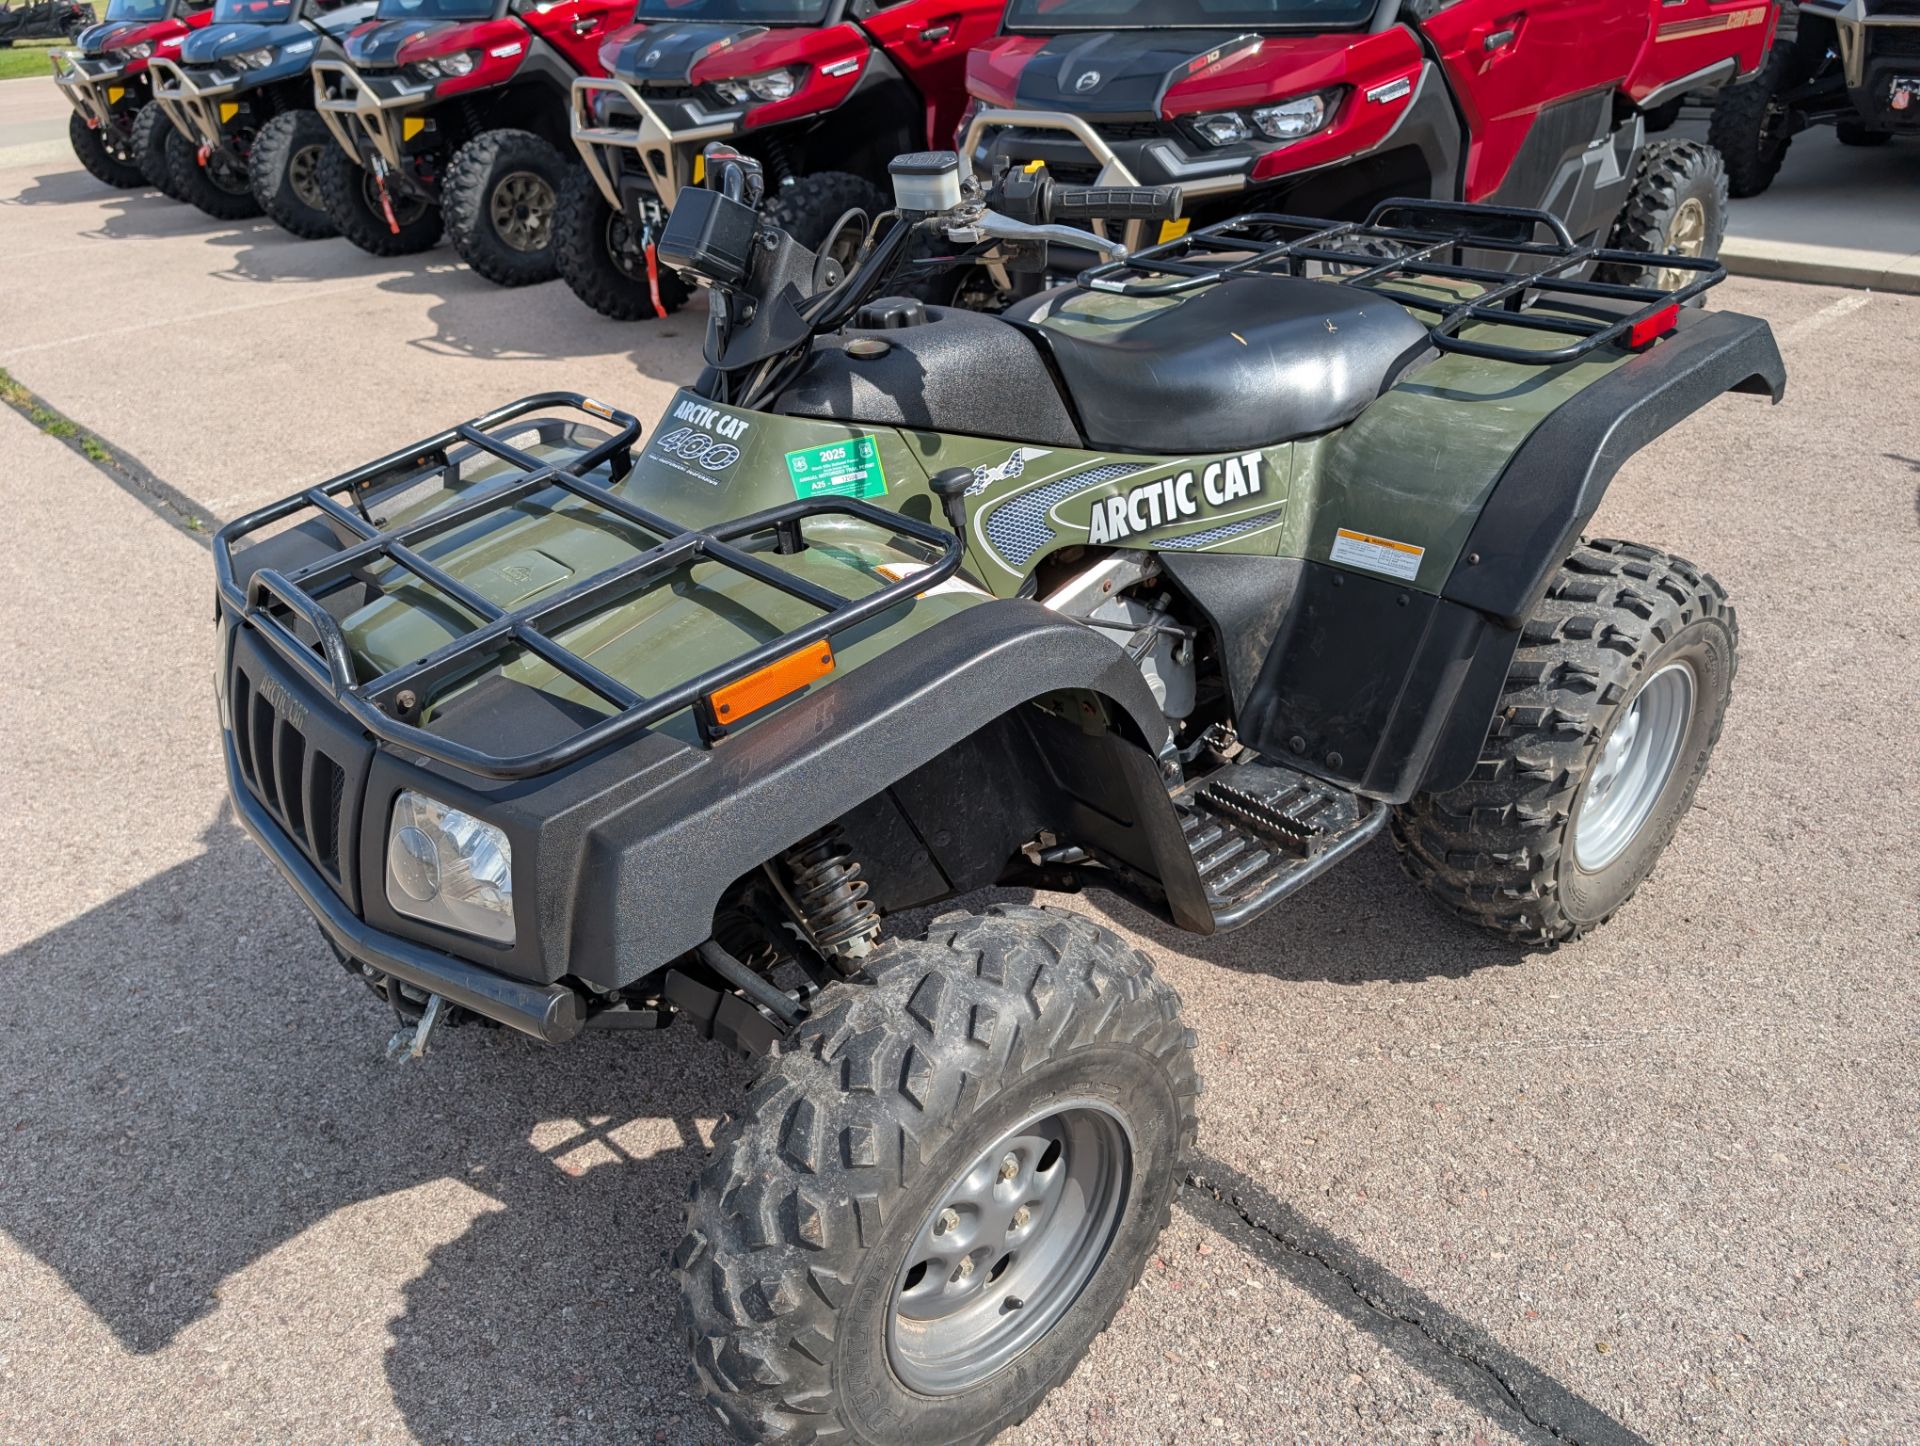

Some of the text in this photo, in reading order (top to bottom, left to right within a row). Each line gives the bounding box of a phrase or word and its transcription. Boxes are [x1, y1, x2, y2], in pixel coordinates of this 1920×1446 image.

[673, 400, 750, 441] ARCTIC CAT
[656, 426, 740, 471] 400
[819, 447, 846, 463] 2025
[1089, 451, 1263, 545] ARCTIC CAT
